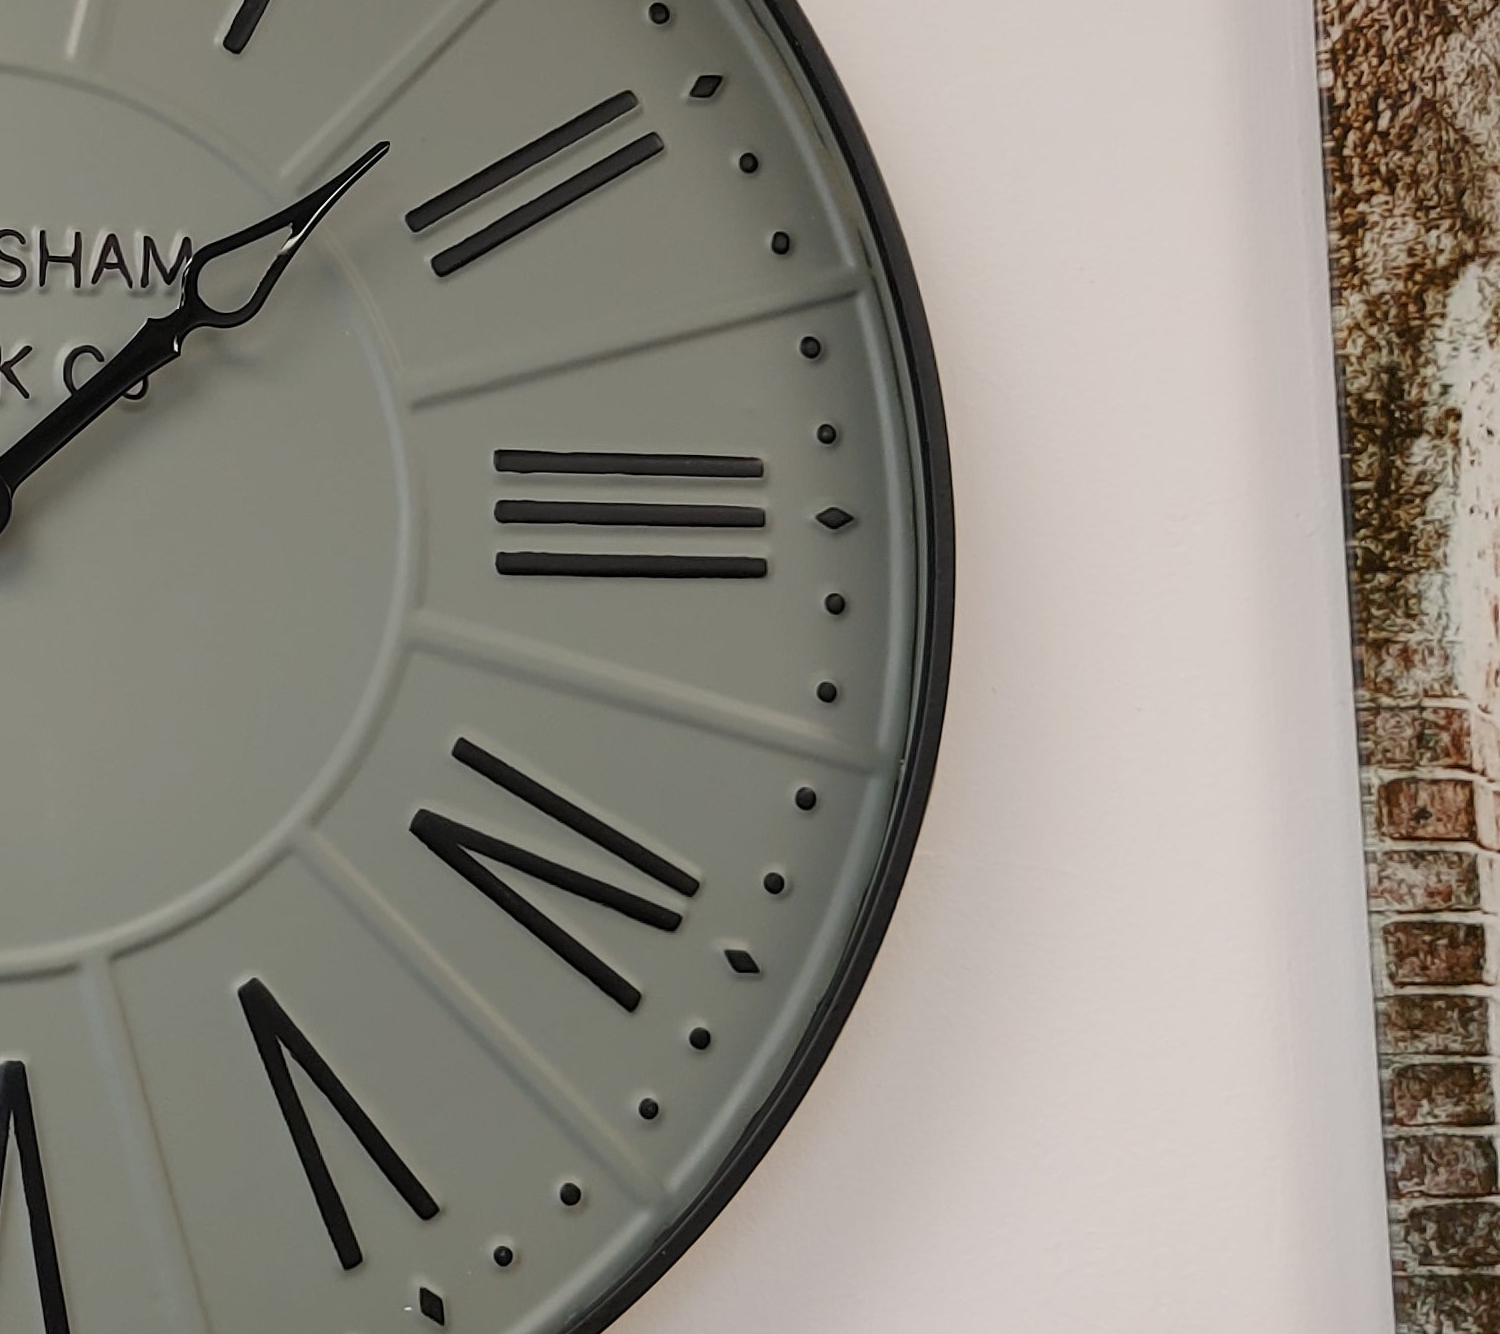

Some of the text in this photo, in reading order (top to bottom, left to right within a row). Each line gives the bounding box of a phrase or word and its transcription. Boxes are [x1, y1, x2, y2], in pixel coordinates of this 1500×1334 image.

[405, 89, 665, 277] II
[494, 449, 768, 579] III
[410, 737, 700, 1013] IV
[237, 977, 440, 1271] V
